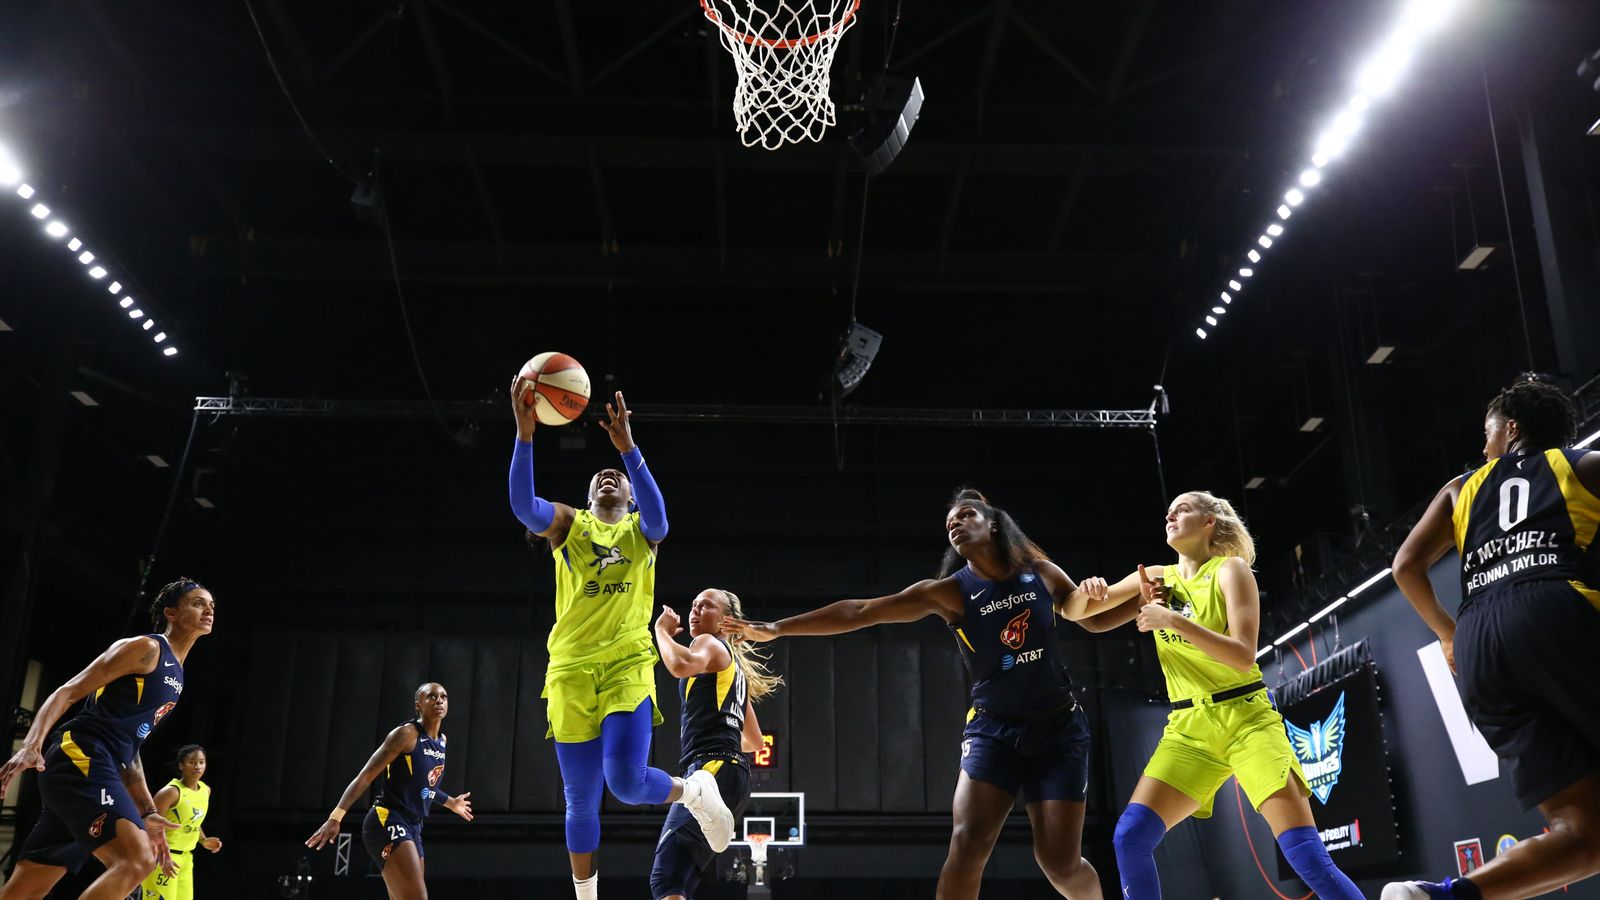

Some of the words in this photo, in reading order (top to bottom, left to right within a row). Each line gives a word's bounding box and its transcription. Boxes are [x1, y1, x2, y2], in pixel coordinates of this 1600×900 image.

[1498, 477, 1530, 532] 0
[1477, 530, 1559, 565] MITCHELL
[1510, 553, 1558, 573] TAYLOR
[602, 582, 633, 595] AT&T
[979, 591, 1038, 616] salesforce
[1015, 648, 1044, 665] AT&T
[754, 746, 771, 766] 12
[101, 788, 115, 806] 4
[387, 824, 406, 840] 25
[156, 873, 170, 887] 52
